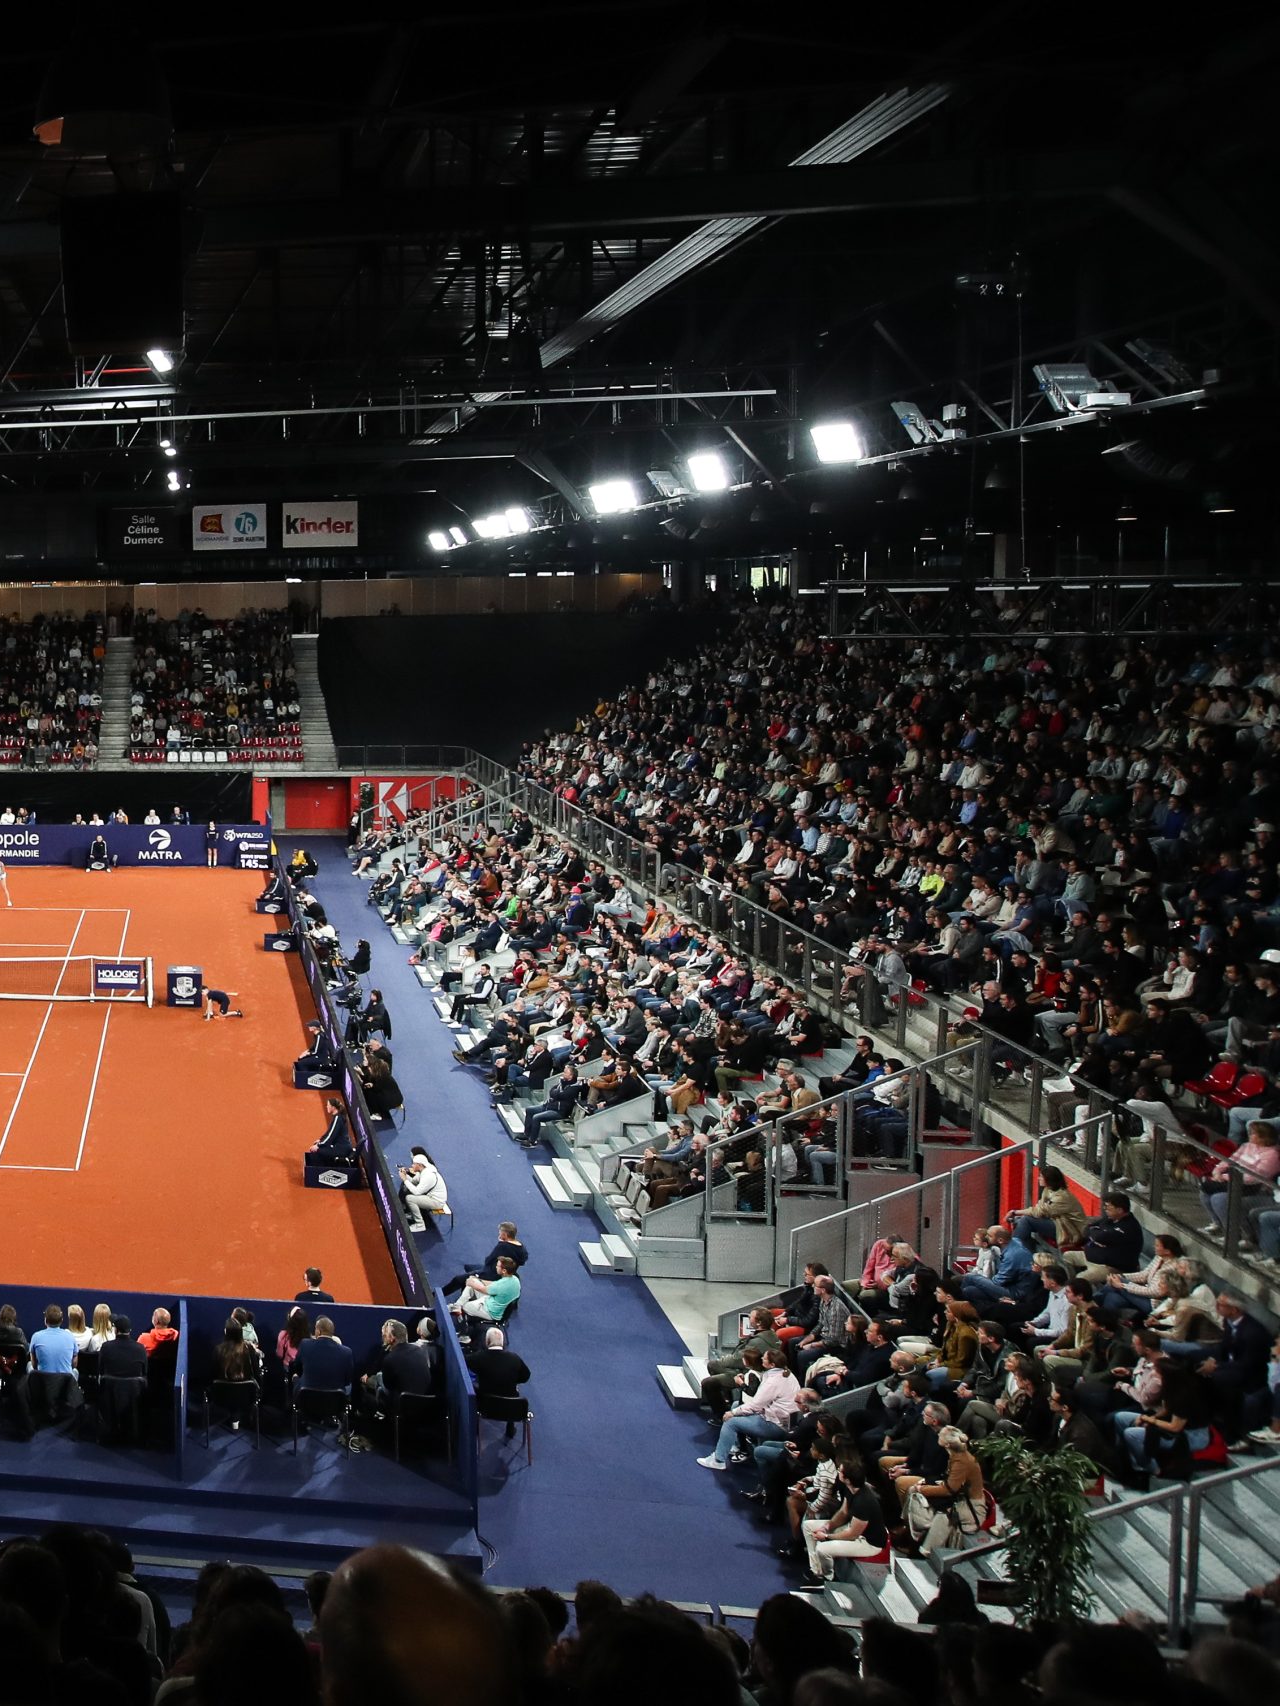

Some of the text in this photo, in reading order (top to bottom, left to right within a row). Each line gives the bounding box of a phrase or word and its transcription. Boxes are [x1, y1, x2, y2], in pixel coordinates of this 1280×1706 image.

[131, 514, 155, 525] Salle
[238, 512, 254, 533] 76
[127, 524, 160, 535] Céline
[123, 535, 164, 546] Dumerc
[138, 850, 183, 860] MATRA
[240, 859, 259, 868] 145
[97, 969, 139, 978] HOLOGIC
